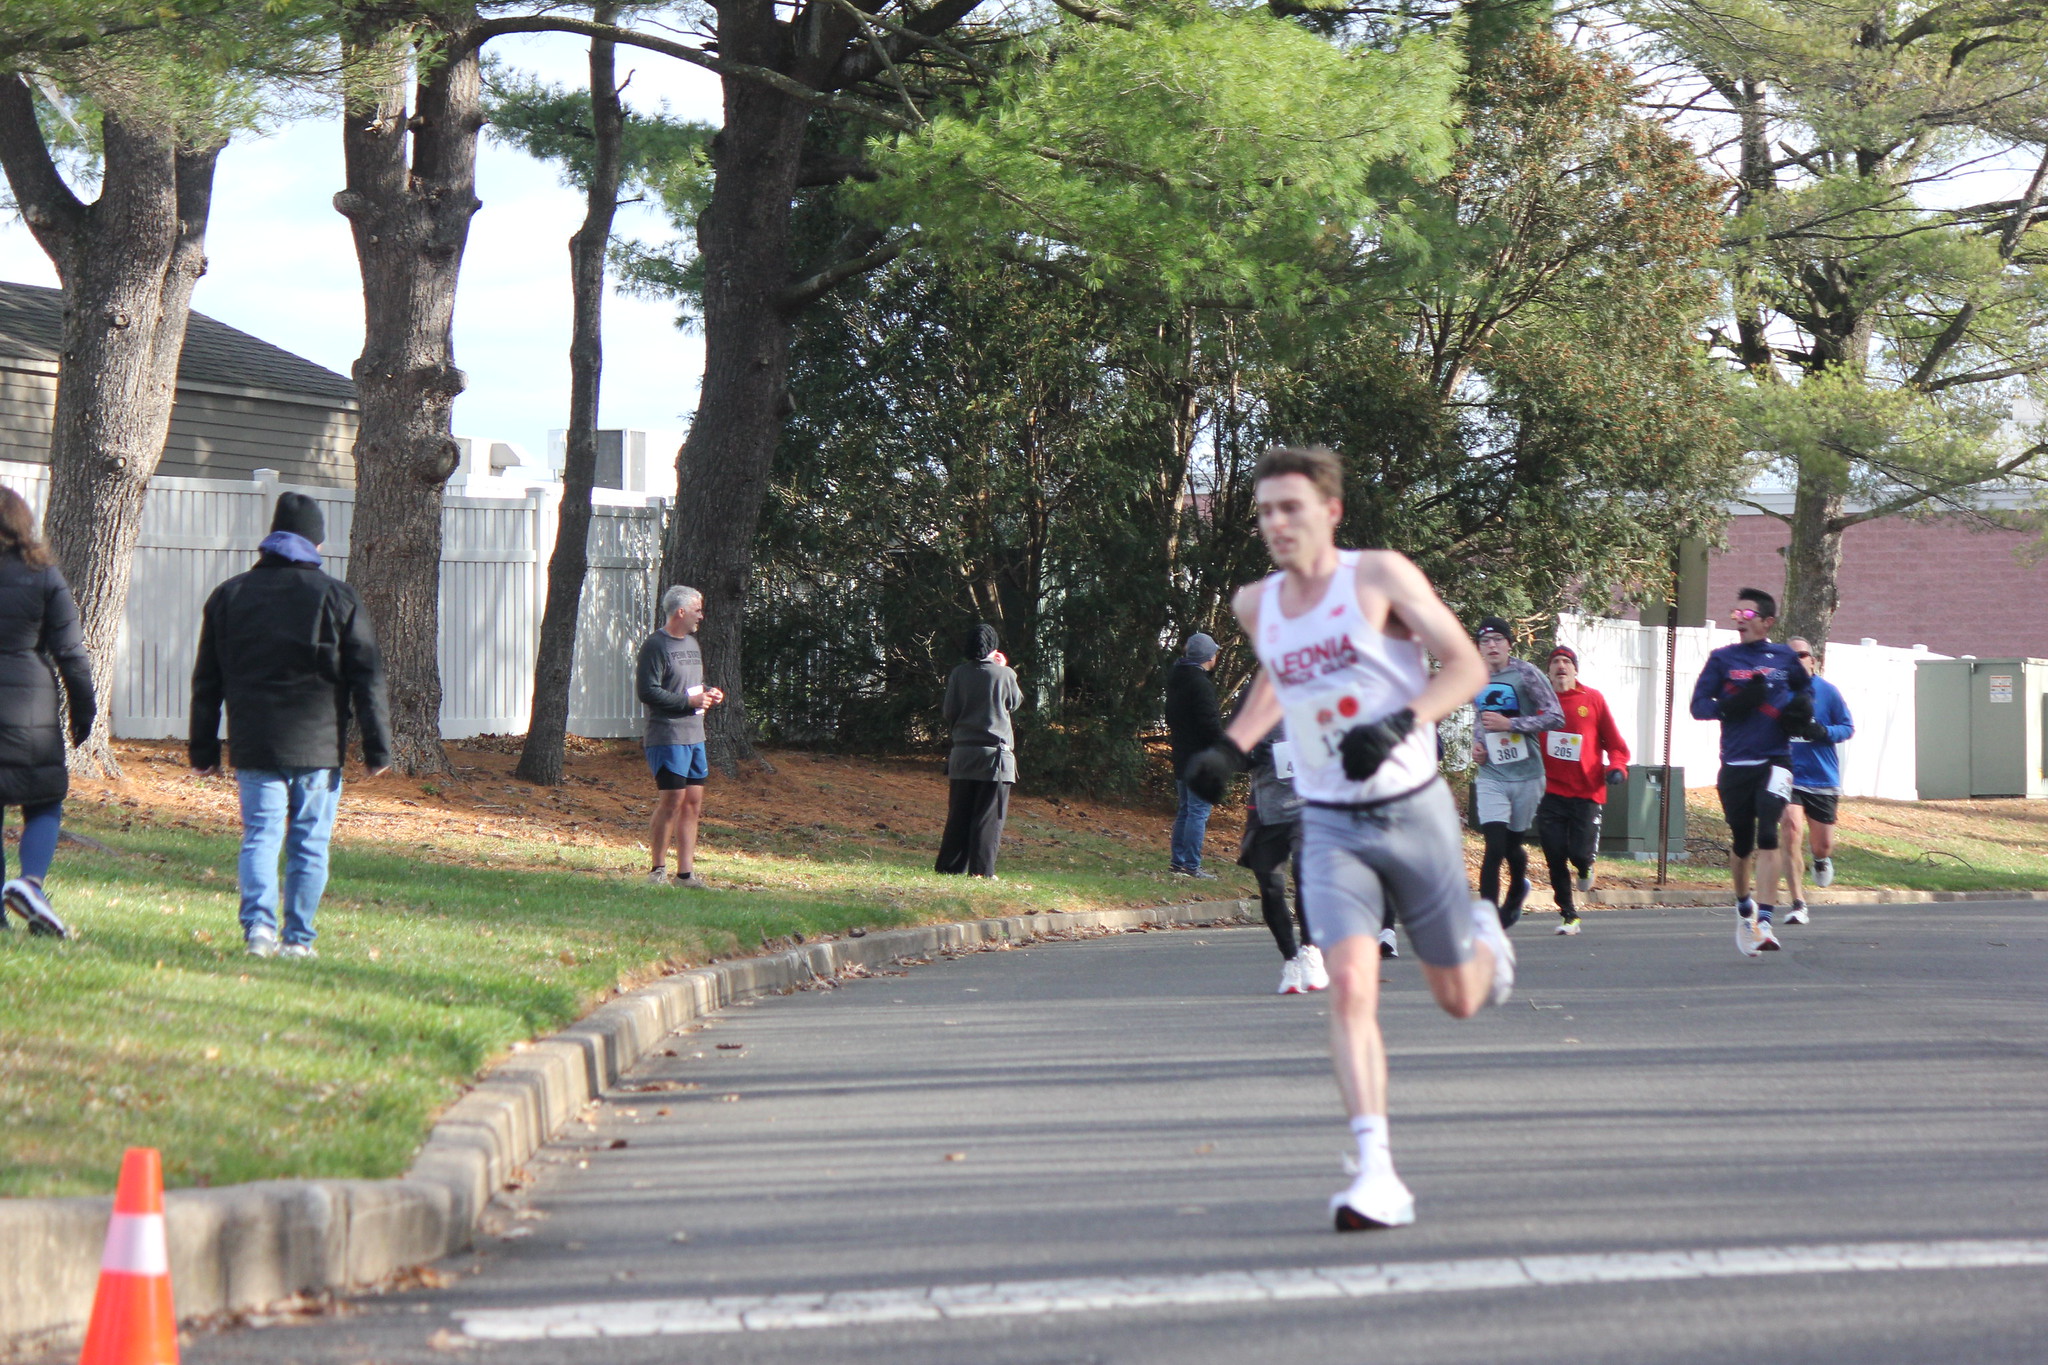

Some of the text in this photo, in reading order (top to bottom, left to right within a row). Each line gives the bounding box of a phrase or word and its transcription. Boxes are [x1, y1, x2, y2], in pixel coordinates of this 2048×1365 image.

[1271, 633, 1356, 677] LEONIA
[1496, 747, 1518, 761] 380
[1554, 746, 1572, 758] 205
